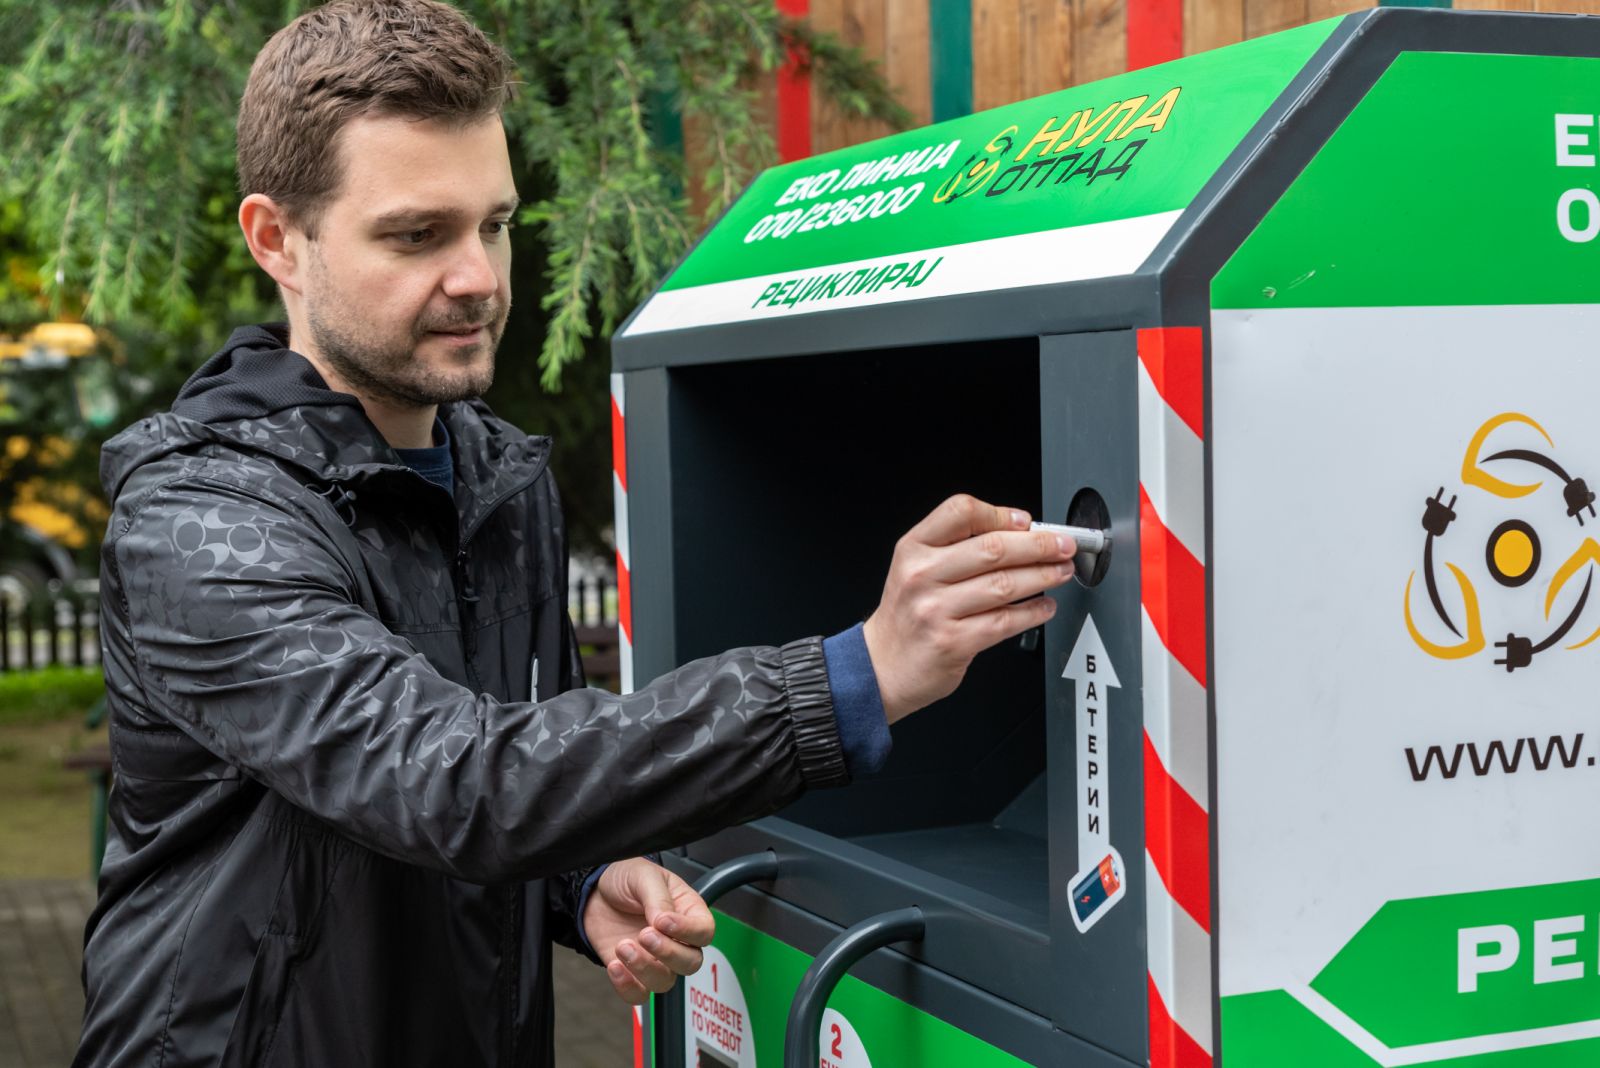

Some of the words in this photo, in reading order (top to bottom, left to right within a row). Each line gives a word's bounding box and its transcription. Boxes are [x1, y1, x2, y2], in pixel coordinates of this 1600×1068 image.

[1013, 86, 1182, 162] НУЛА
[1554, 113, 1600, 168] Е
[774, 168, 841, 207] ЕКО
[829, 139, 962, 194] ЛИНИЈА
[985, 138, 1148, 197] ОТПАД
[743, 181, 926, 244] 070/236000
[751, 256, 944, 309] РЕЦИКЛИРАЈ
[1085, 653, 1099, 835] БАТЕРИИ
[1404, 732, 1600, 782] www.
[711, 962, 718, 993] 1
[1457, 912, 1600, 994] РЕ
[690, 986, 742, 1032] ПОСТАВЕТЕ
[693, 1010, 704, 1032] ГО
[705, 1017, 742, 1056] УРЕДОТ
[831, 1022, 843, 1060] 2
